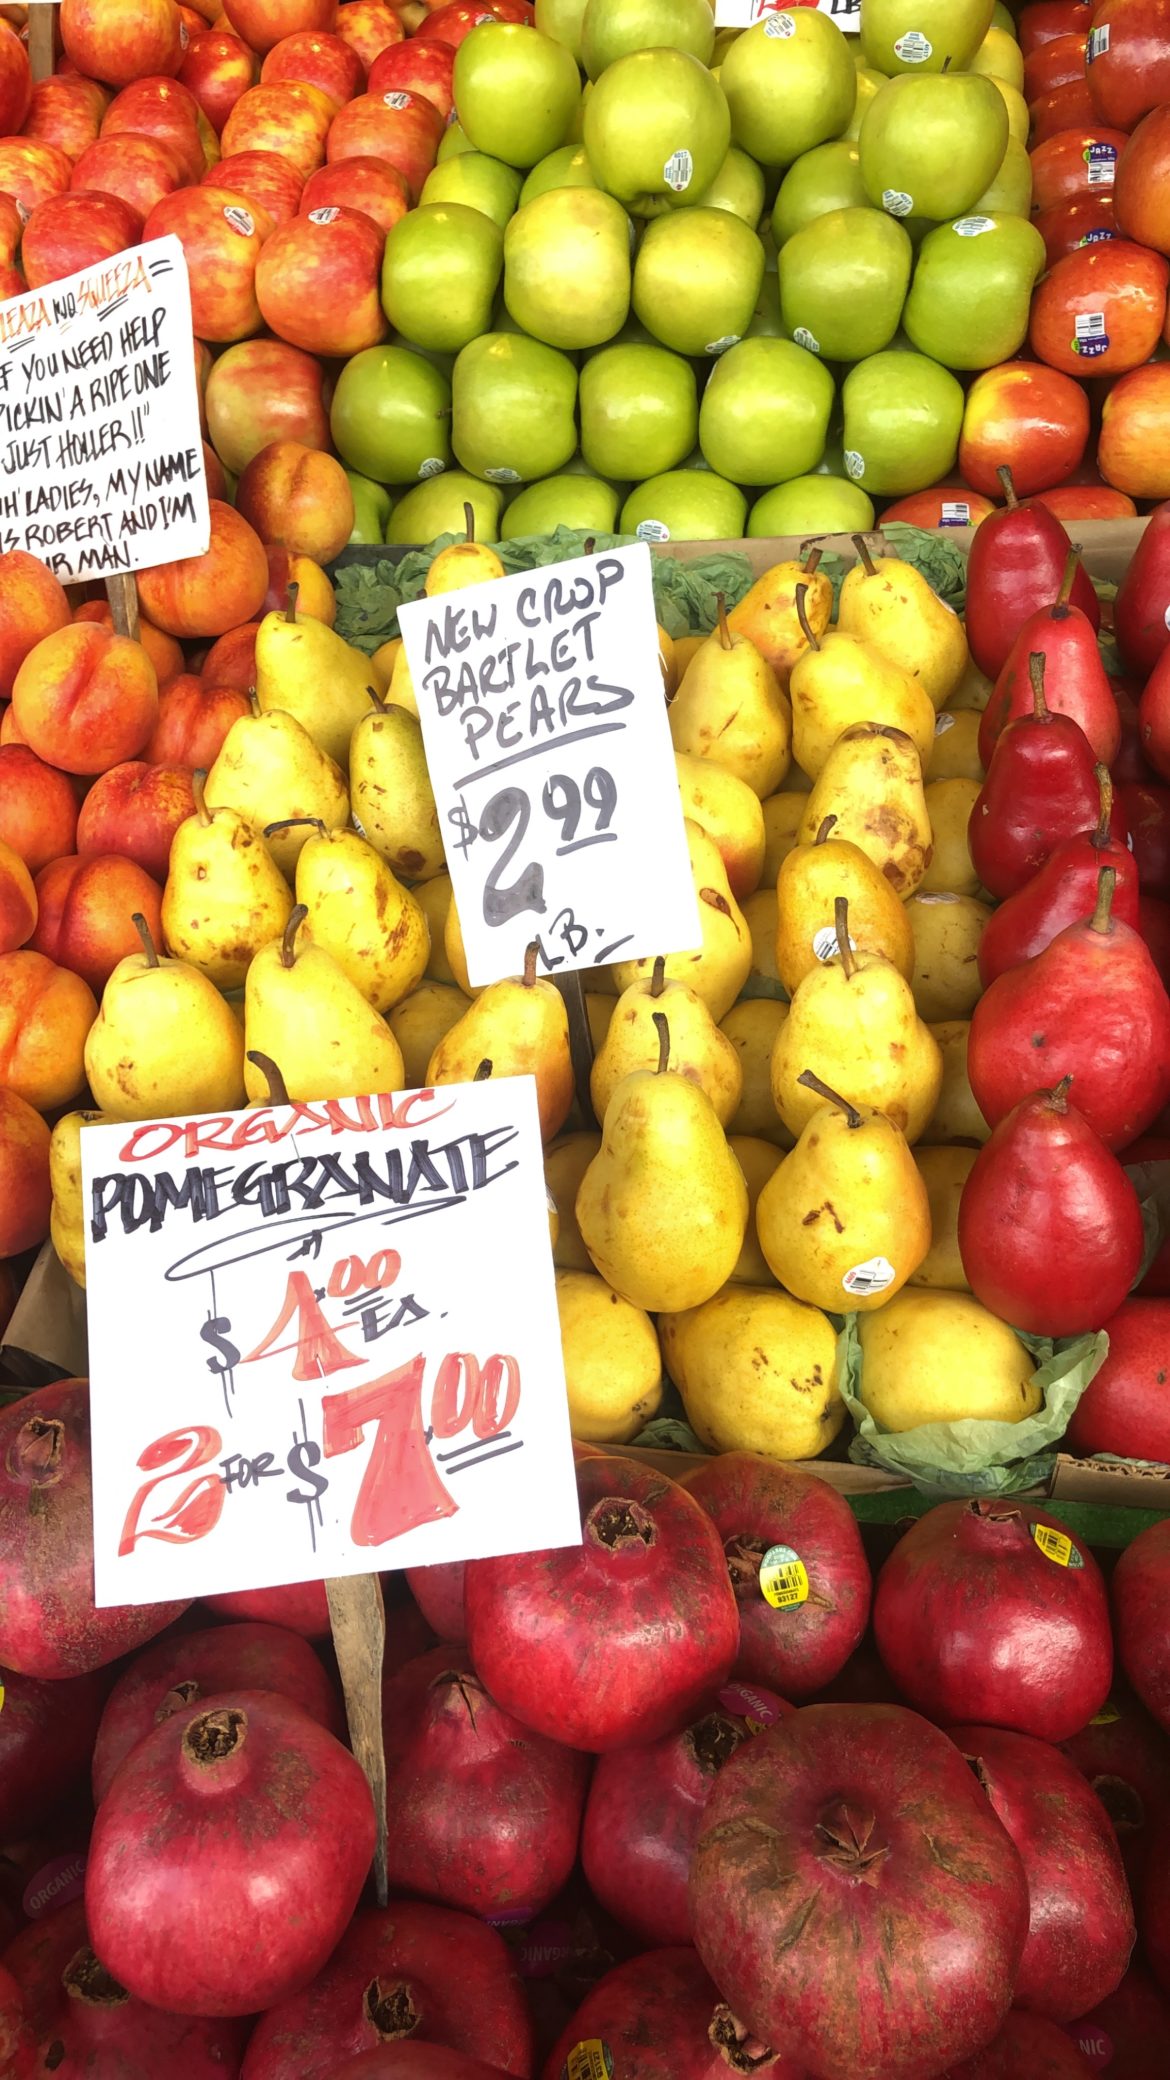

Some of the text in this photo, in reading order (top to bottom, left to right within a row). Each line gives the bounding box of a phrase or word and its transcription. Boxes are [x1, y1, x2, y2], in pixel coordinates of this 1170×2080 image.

[21, 353, 59, 395] YOU
[62, 331, 113, 374] NEED
[119, 307, 166, 358] HELP
[70, 384, 86, 420] A
[90, 364, 132, 412] RIPE
[134, 350, 171, 395] ONE
[1, 435, 52, 475] JUST
[106, 460, 141, 505] MY
[145, 448, 201, 492] NAME
[25, 513, 114, 551] ROBERT
[119, 503, 157, 539] AND
[78, 540, 139, 574] MAN.
[425, 558, 625, 664] NEW CROP
[422, 612, 601, 716] BARTLET
[460, 675, 635, 760] PEARS
[118, 1088, 457, 1162] ORGANIC
[91, 1125, 519, 1244] POMEGRANATE
[118, 1425, 226, 1557] 2
[220, 1452, 285, 1494] FOR
[30, 1860, 86, 1910] ORGANIC
[520, 1945, 570, 1962] RGANIC
